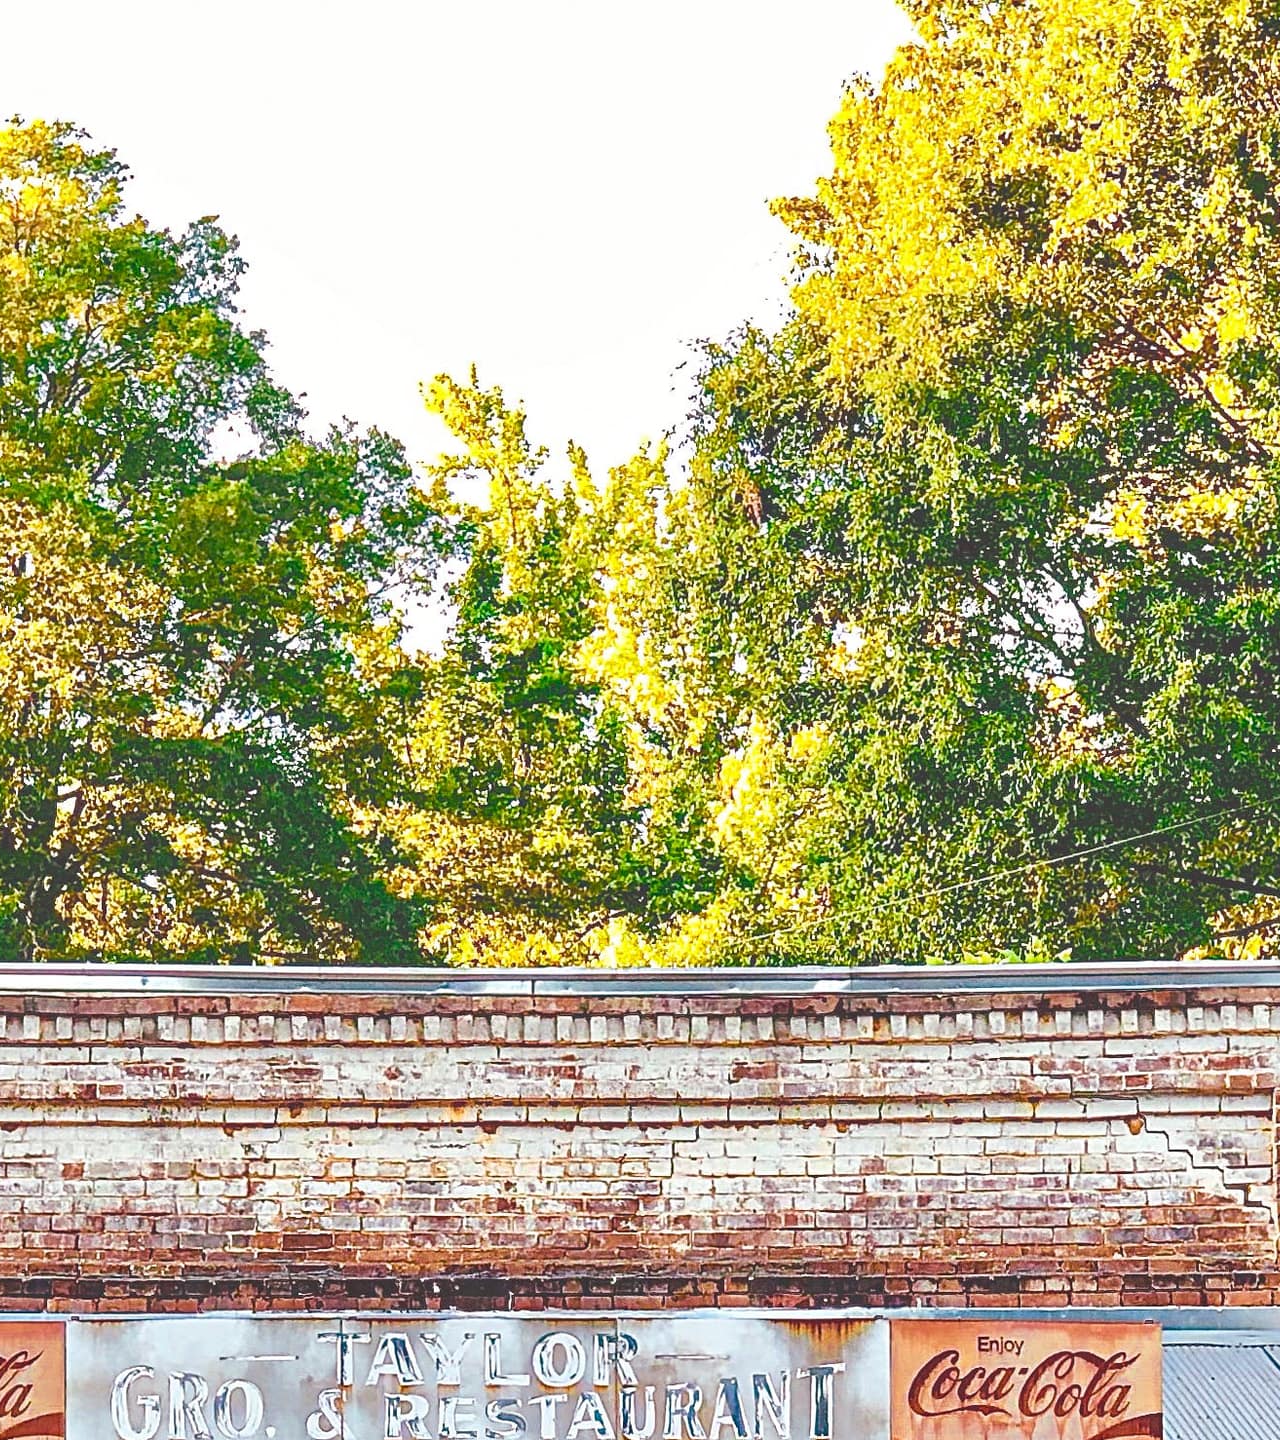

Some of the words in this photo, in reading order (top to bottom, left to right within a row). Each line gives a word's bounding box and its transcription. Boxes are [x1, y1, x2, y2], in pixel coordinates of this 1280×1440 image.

[318, 1332, 639, 1388] TAYLOR
[977, 1336, 1025, 1356] Enjoy
[907, 1349, 1142, 1418] Coca-Cola
[305, 1389, 356, 1440] &
